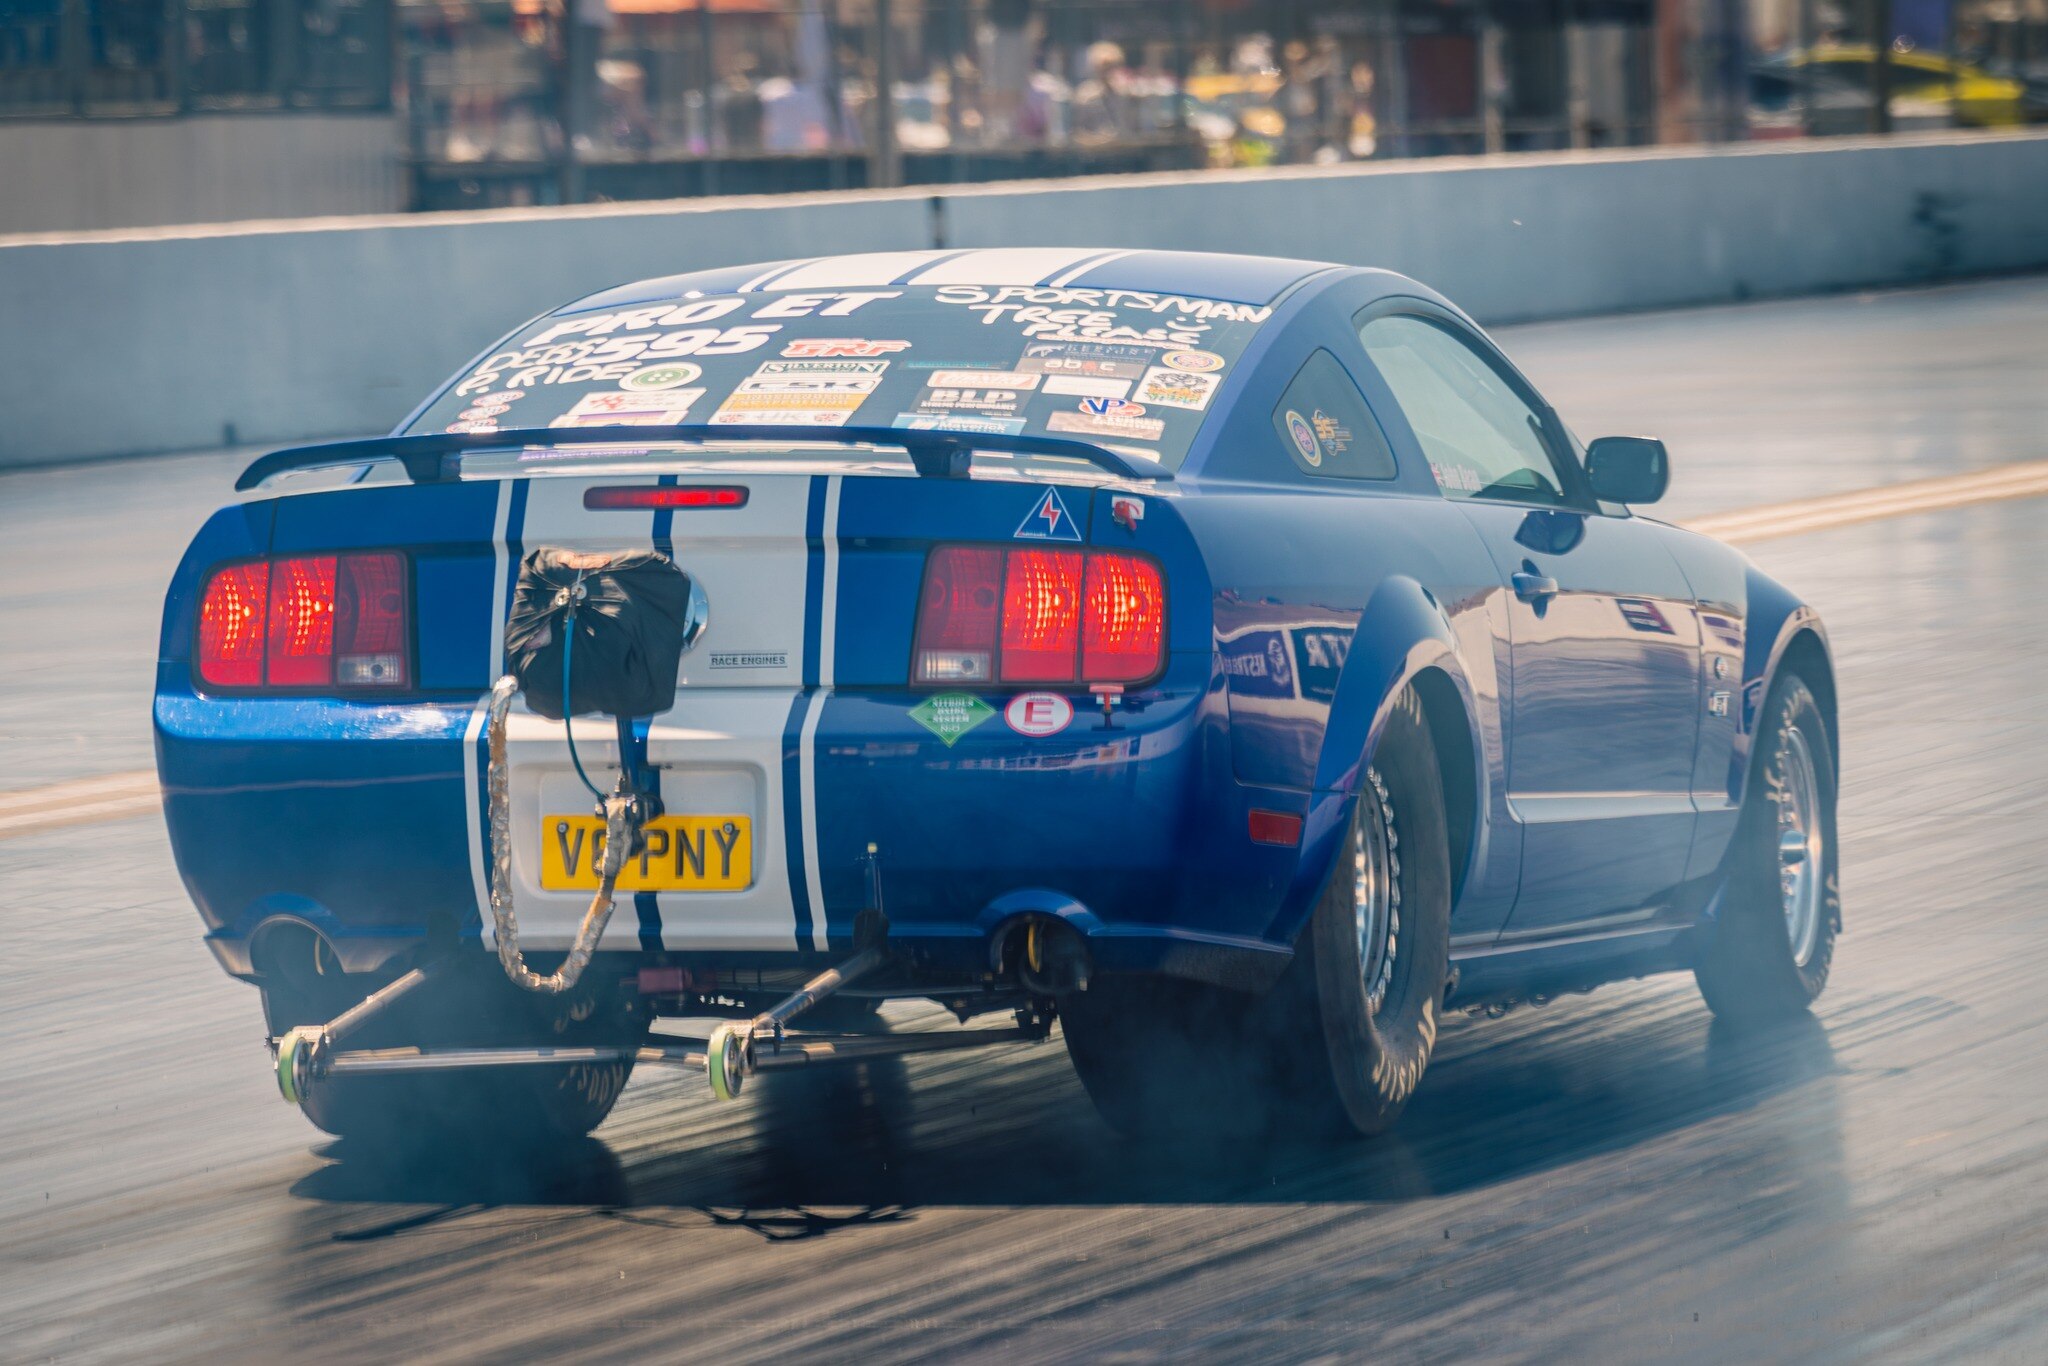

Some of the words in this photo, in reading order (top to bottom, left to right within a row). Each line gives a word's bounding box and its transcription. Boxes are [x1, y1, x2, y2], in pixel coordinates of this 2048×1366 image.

[935, 285, 1273, 323] SPORTSMAN
[968, 304, 1118, 328] TREE
[523, 298, 746, 348] PRO
[751, 291, 904, 318] ET
[573, 323, 784, 367] 595
[1022, 323, 1201, 345] PLEASE
[506, 360, 643, 389] RIDE
[929, 389, 1018, 402] BLP
[711, 657, 738, 666] RACE
[741, 656, 786, 665] ENGINES
[931, 697, 974, 707] NITROUS
[1023, 701, 1054, 727] E
